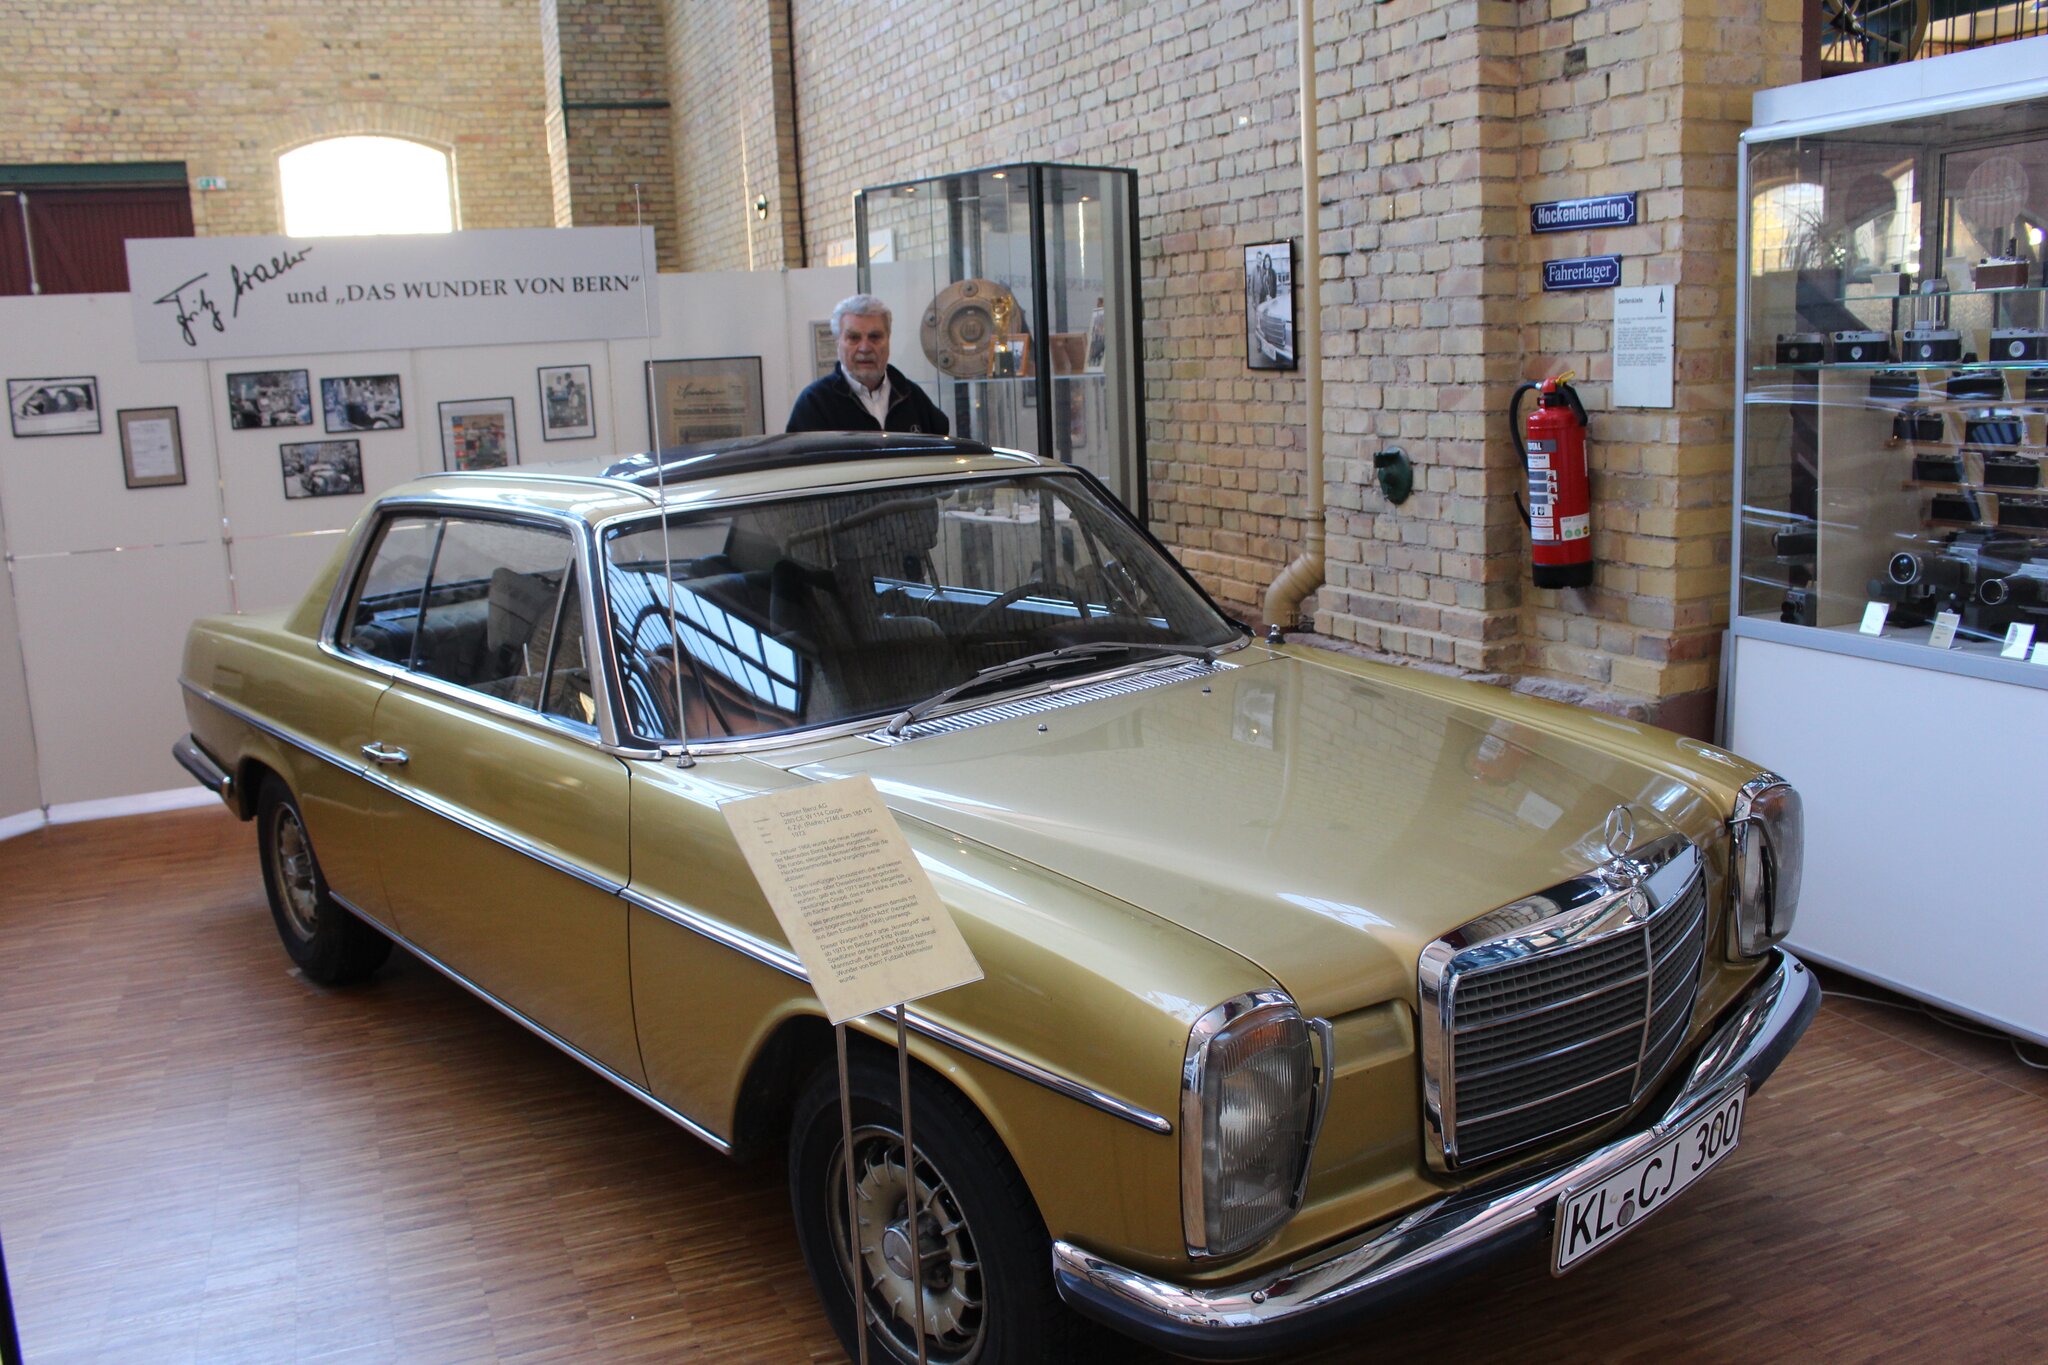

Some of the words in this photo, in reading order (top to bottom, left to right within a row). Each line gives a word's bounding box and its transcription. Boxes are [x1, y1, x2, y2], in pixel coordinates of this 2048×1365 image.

[1537, 201, 1625, 225] Hockenheimring
[1549, 263, 1612, 283] Fahrerlager
[286, 287, 329, 304] und
[402, 279, 507, 299] WUNDER
[514, 276, 565, 294] VON
[1691, 1099, 1739, 1171] 300
